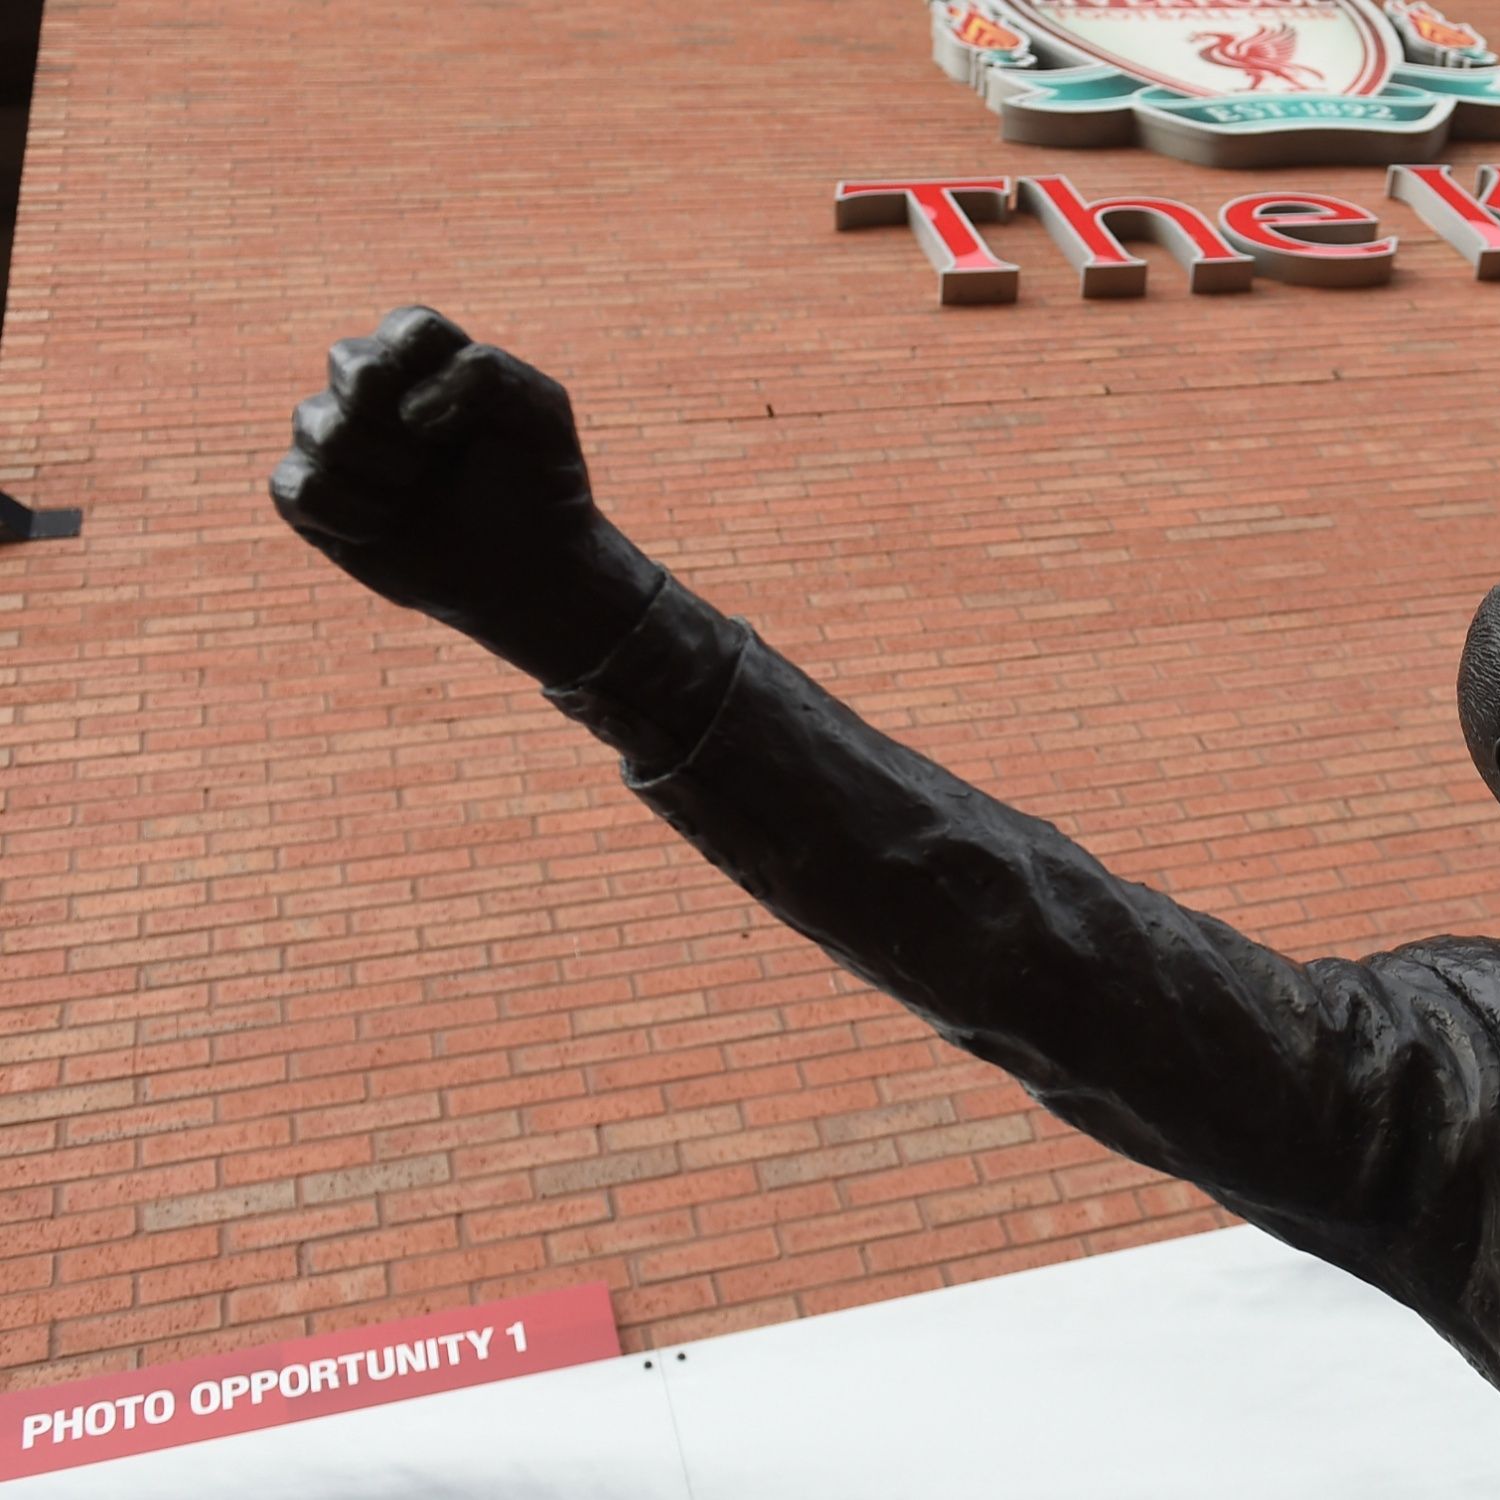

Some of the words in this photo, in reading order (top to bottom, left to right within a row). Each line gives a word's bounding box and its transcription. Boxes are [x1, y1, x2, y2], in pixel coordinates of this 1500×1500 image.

[836, 173, 1398, 304] The
[22, 1389, 174, 1449] PHOTO
[189, 1325, 495, 1416] OPPORTUNITY
[505, 1321, 528, 1353] 1
